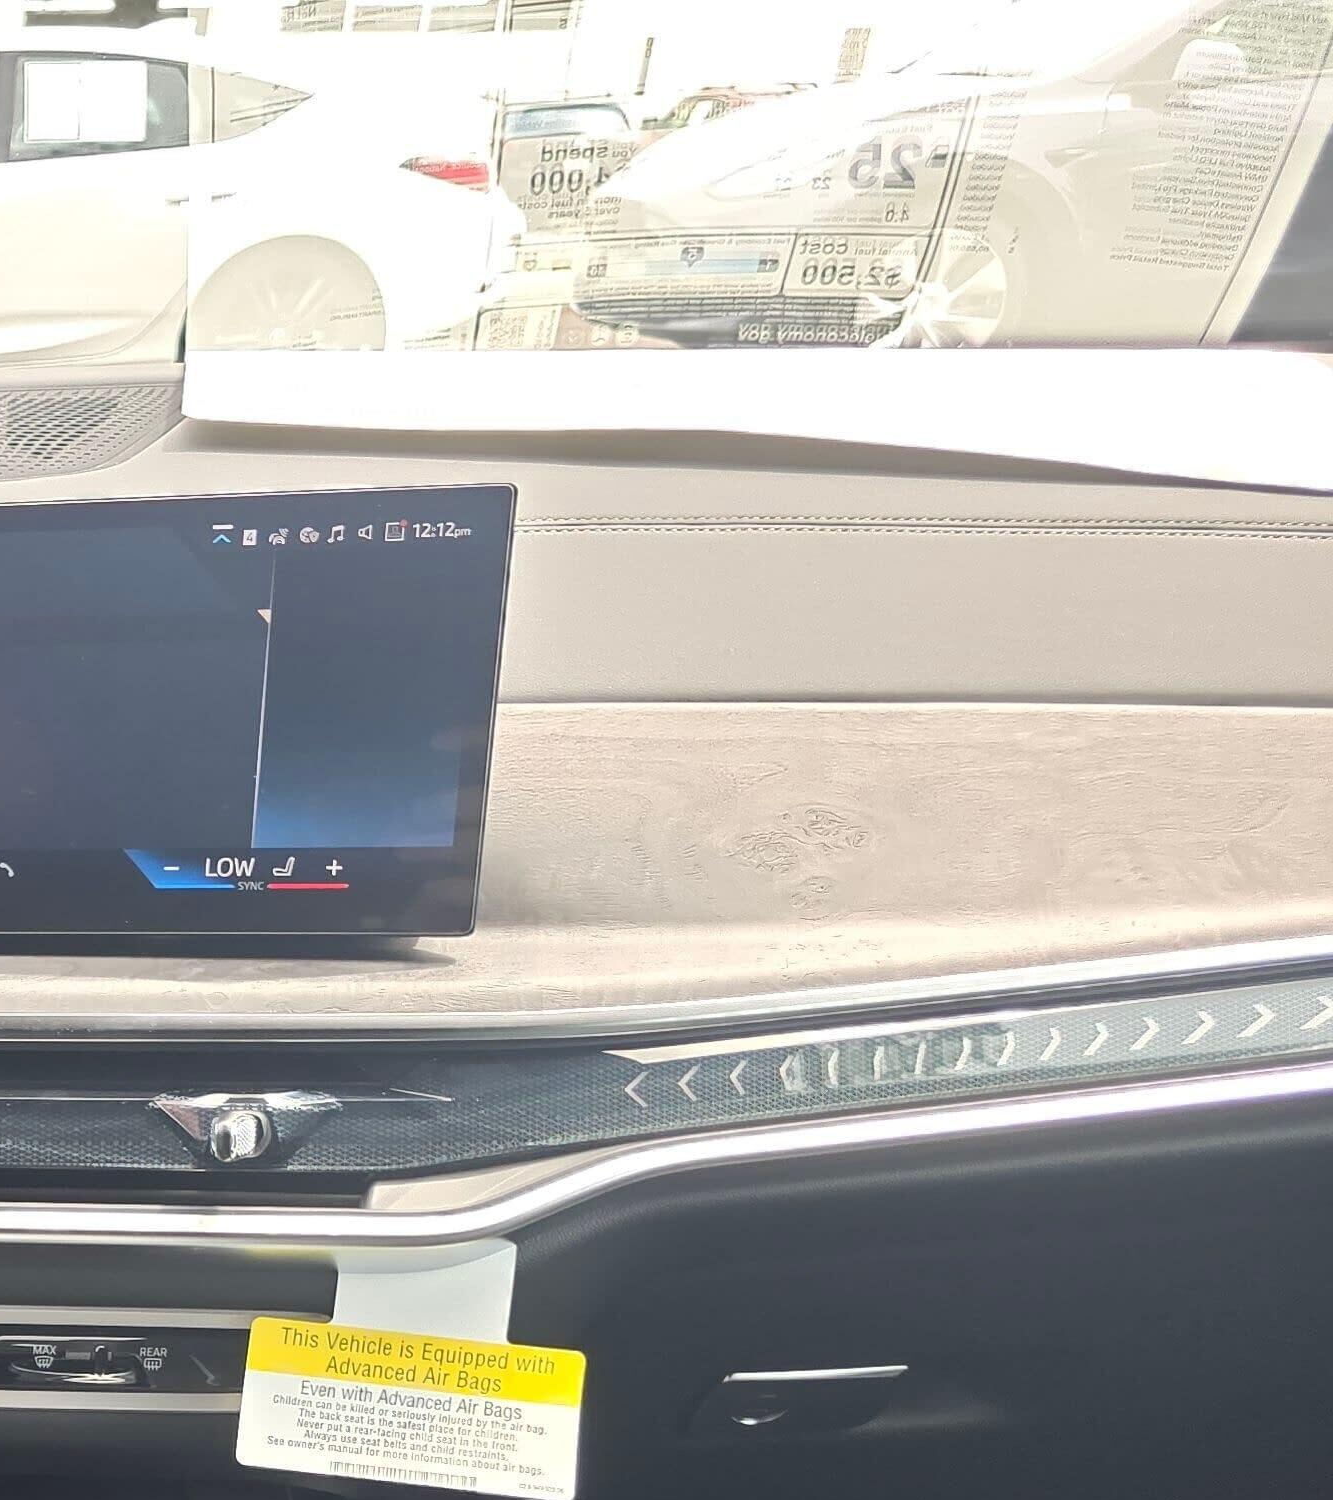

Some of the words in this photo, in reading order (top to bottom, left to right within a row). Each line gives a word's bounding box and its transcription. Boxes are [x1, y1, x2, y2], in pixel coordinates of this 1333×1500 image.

[205, 857, 256, 877] LOW
[237, 881, 265, 891] SYNC
[33, 1345, 57, 1355] MAX
[139, 1347, 168, 1357] REAR
[281, 1326, 319, 1348] This
[326, 1331, 393, 1357] Vehicle
[399, 1341, 414, 1358] is
[422, 1343, 509, 1370] Equipped
[516, 1355, 555, 1375] with
[325, 1356, 416, 1384] Advanced
[422, 1366, 449, 1387] Air
[456, 1371, 503, 1395] Bags
[273, 1394, 313, 1408] Children
[315, 1401, 333, 1410] can
[335, 1401, 347, 1411] be
[349, 1403, 375, 1415] killed
[378, 1408, 389, 1416] or
[391, 1408, 436, 1424] seriously
[438, 1413, 473, 1427] injured
[476, 1418, 487, 1430] by
[491, 1419, 507, 1430] the
[510, 1422, 524, 1432] air
[300, 1380, 336, 1399] Even
[342, 1385, 373, 1403] with
[377, 1388, 452, 1412] Advanced
[456, 1398, 479, 1415] Air
[483, 1401, 523, 1421] Bags
[296, 1418, 325, 1430] Never
[327, 1422, 343, 1433] put
[354, 1426, 407, 1441] rear-facing
[409, 1431, 433, 1443] child
[436, 1434, 457, 1445] seat
[459, 1437, 469, 1446] in
[472, 1438, 488, 1449] the
[299, 1408, 316, 1418] The
[319, 1410, 341, 1422] back
[344, 1415, 364, 1425] seat
[367, 1416, 375, 1425] is
[378, 1418, 394, 1428] the
[396, 1419, 426, 1432] safest
[428, 1423, 454, 1436] place
[457, 1426, 471, 1436] for
[267, 1435, 285, 1446] See
[328, 1443, 363, 1456] manual
[366, 1447, 380, 1457] for
[383, 1450, 408, 1460] more
[410, 1452, 469, 1467] information
[471, 1459, 500, 1471] about
[503, 1462, 516, 1472] air
[303, 1429, 337, 1443] Always
[340, 1435, 357, 1444] use
[360, 1436, 381, 1447] seat
[383, 1438, 407, 1450] belts
[409, 1441, 428, 1451] and
[431, 1443, 455, 1455] child
